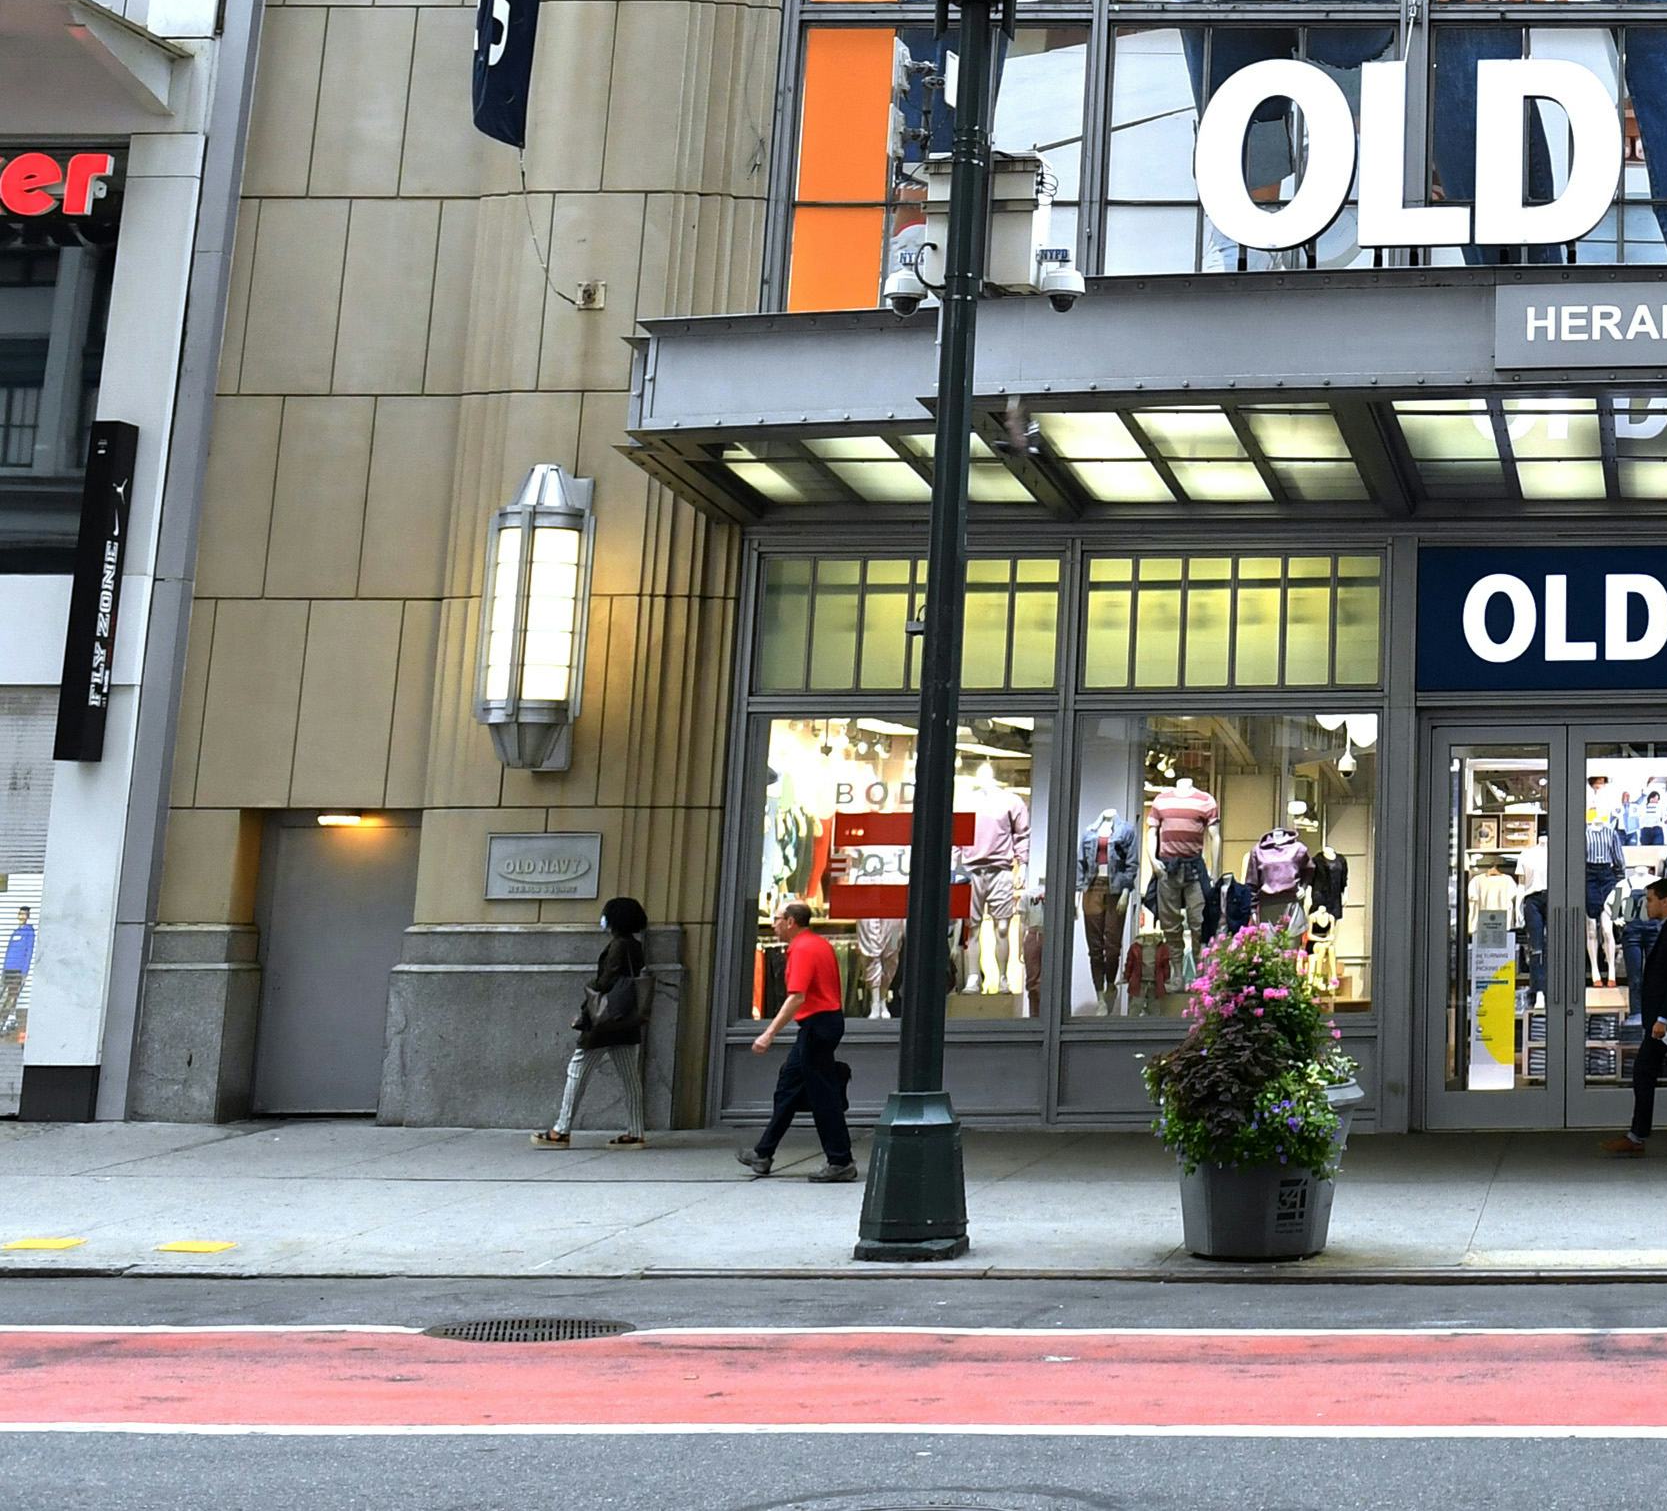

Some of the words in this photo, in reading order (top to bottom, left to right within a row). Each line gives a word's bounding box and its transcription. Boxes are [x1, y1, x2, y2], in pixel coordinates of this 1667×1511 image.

[0, 152, 114, 216] er
[1195, 58, 1621, 249] OLD
[1039, 249, 1068, 260] NYPD
[96, 540, 118, 637] ZONE
[88, 641, 106, 707] FLY
[836, 782, 916, 804] BOD
[504, 859, 536, 874] OLD
[539, 858, 581, 874] NAVY
